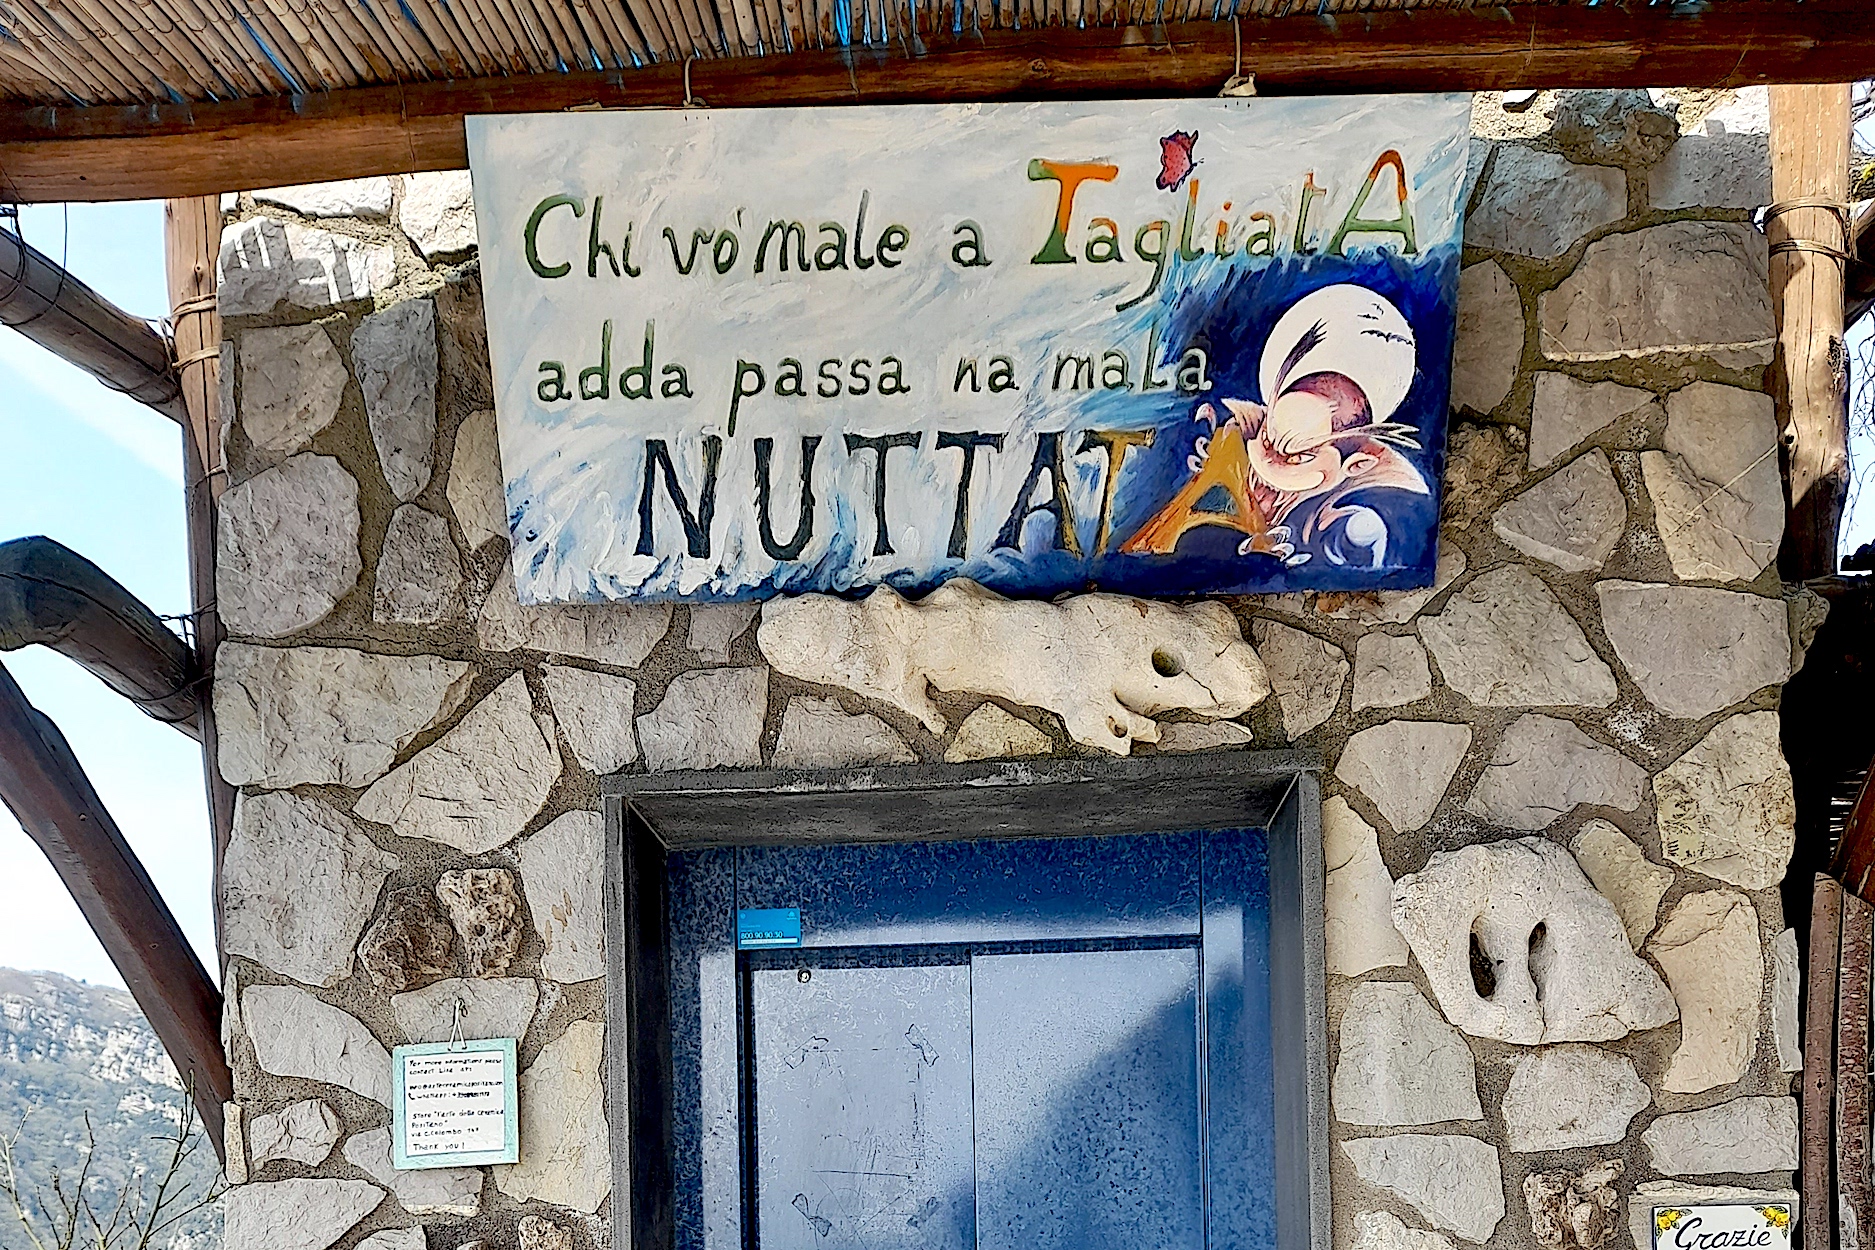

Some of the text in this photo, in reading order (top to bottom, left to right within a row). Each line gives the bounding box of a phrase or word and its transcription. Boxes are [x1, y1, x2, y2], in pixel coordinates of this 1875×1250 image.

[524, 193, 641, 278] Chi
[951, 219, 993, 267] a
[537, 318, 694, 402] adda
[726, 354, 911, 436] passa
[953, 355, 1020, 393] na
[634, 427, 1280, 560] NUTTATA
[412, 1143, 439, 1151] Thank
